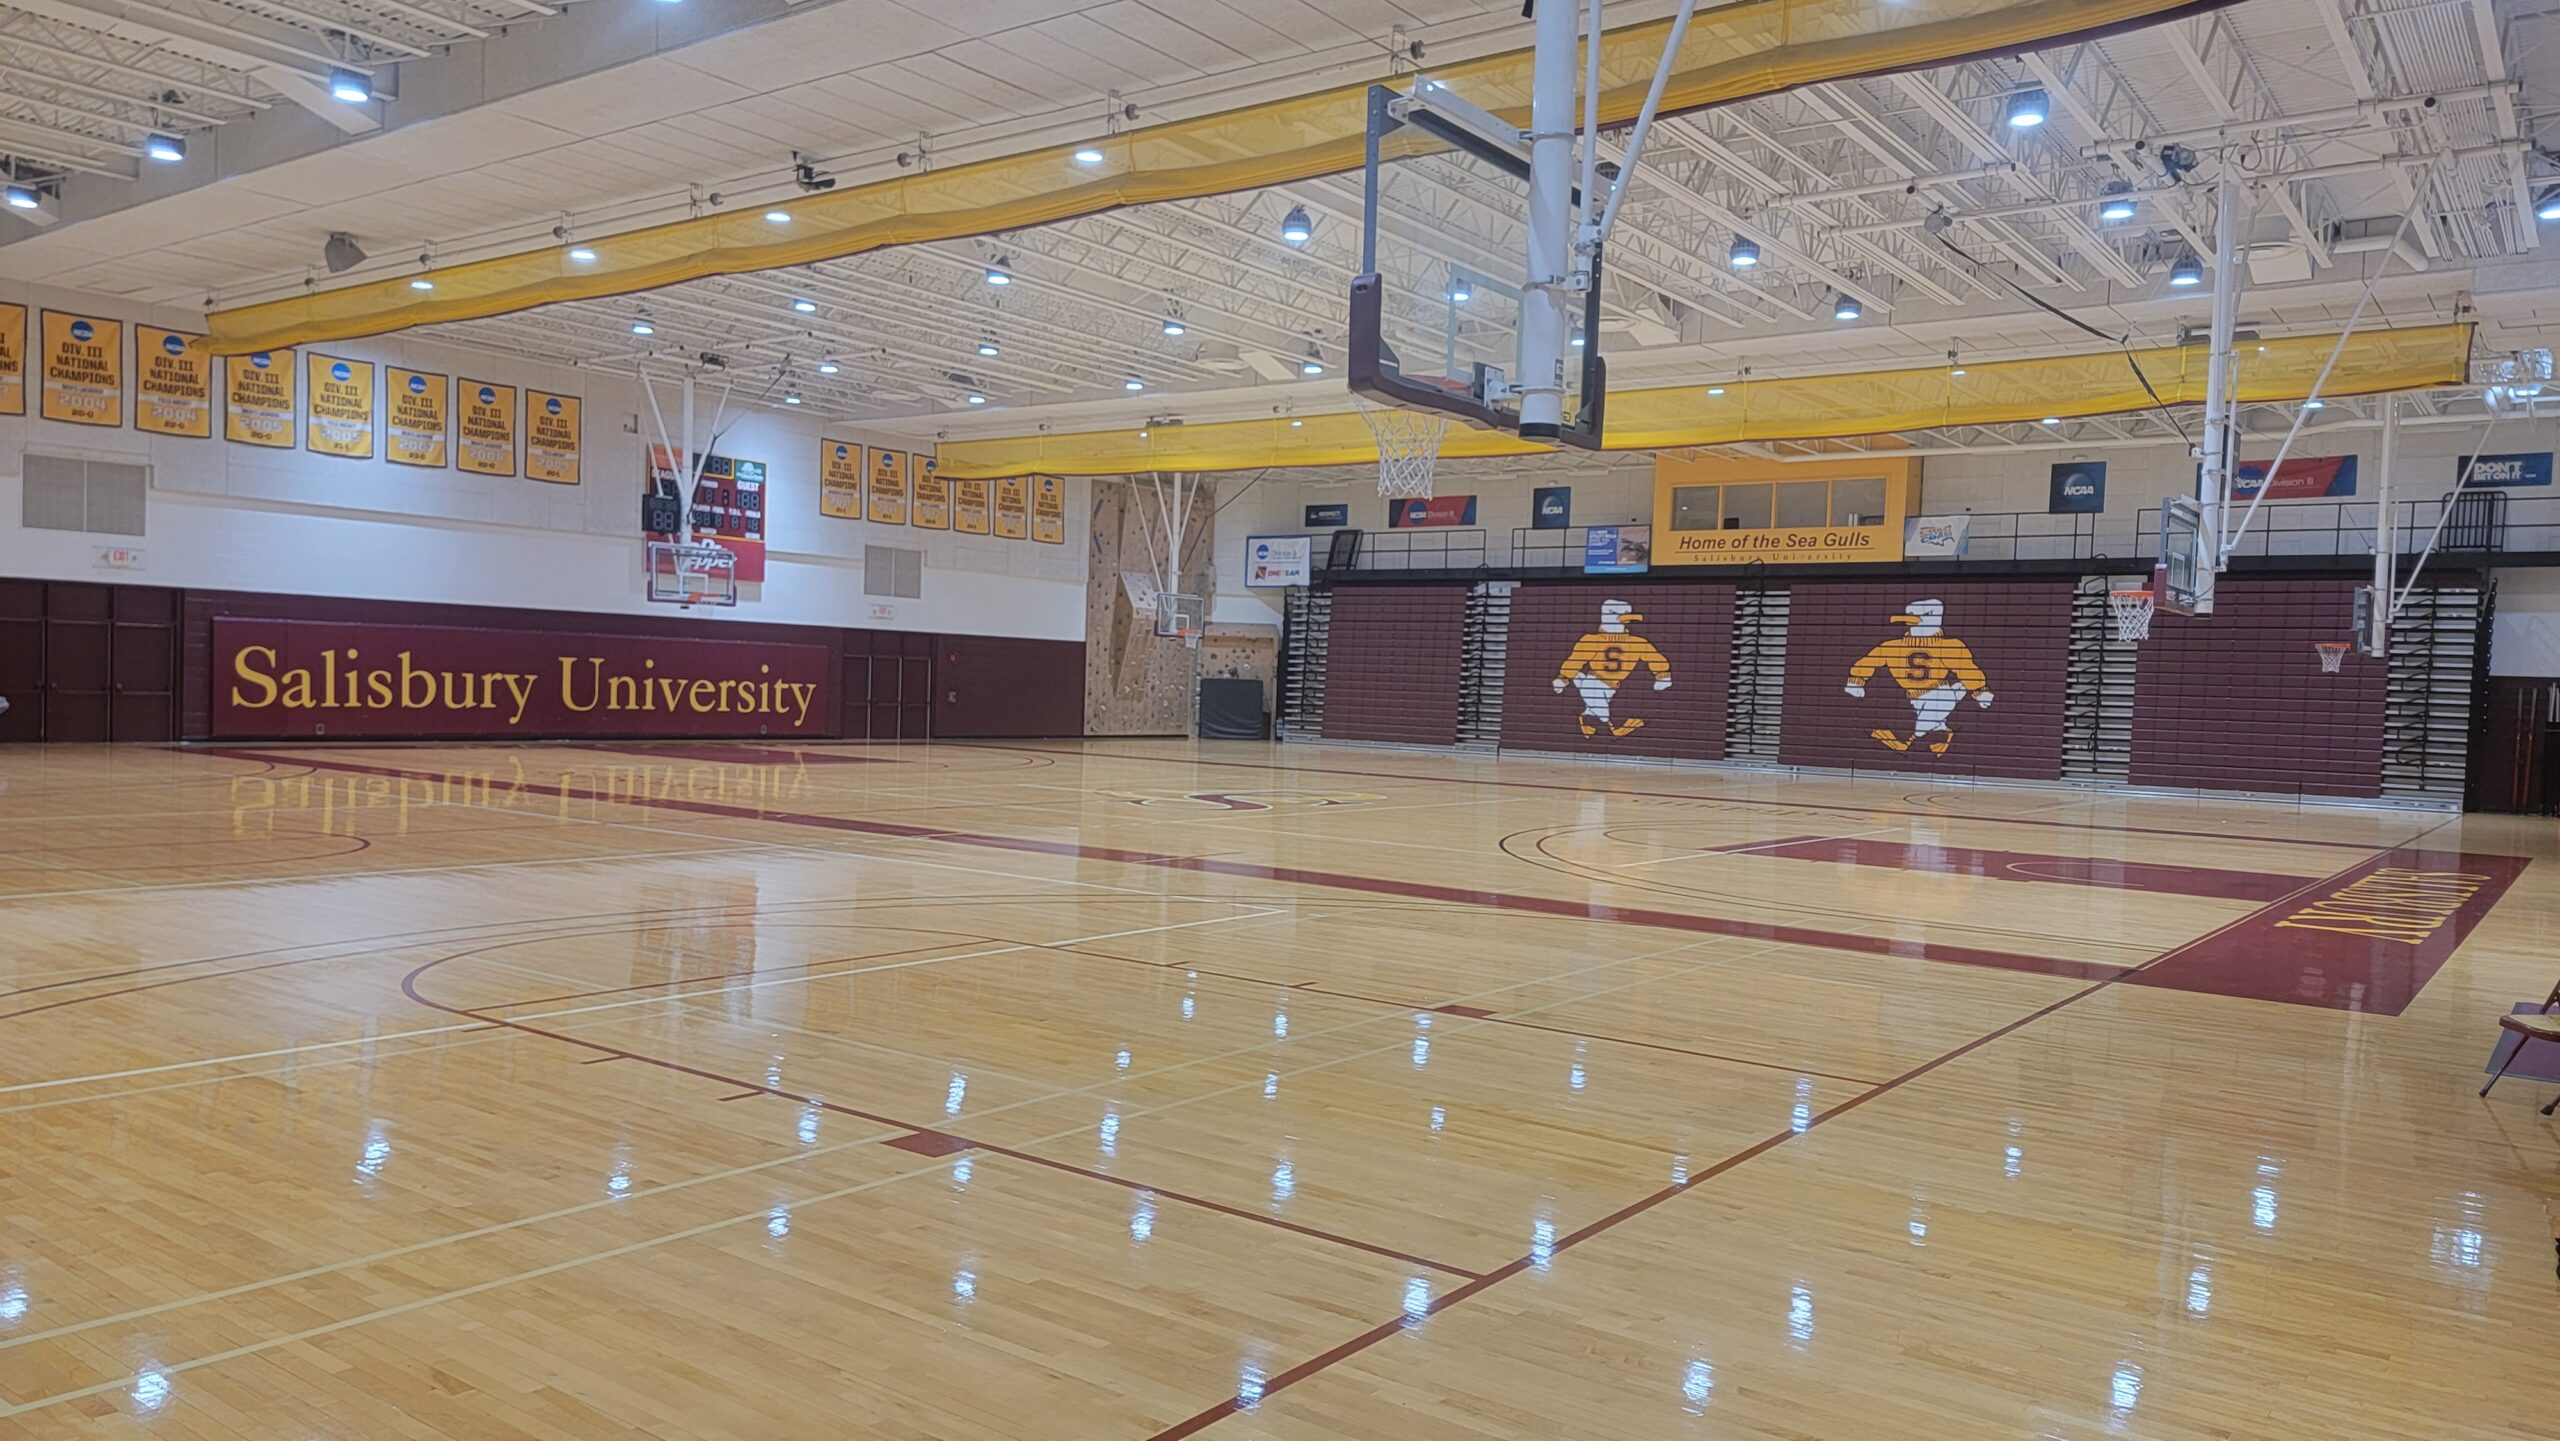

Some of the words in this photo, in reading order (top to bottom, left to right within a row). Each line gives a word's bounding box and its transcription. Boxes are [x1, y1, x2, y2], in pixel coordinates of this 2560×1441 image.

[62, 342, 84, 356] DIV.
[88, 345, 102, 358] III
[56, 354, 109, 371] NATIONAL
[155, 356, 176, 369] DIV.
[179, 360, 193, 371] III
[50, 367, 115, 385] CHAMPIONS
[150, 369, 199, 384] NATIONAL
[243, 370, 262, 382] DIV.
[265, 373, 279, 384] III
[144, 380, 205, 398] CHAMPIONS
[238, 381, 284, 397] NATIONAL
[324, 382, 343, 394] DIV.
[345, 386, 358, 396] III
[232, 392, 290, 409] CHAMPIONS
[320, 394, 363, 408] NATIONAL
[402, 394, 419, 406] DIV.
[421, 397, 432, 408] III
[314, 404, 369, 421] CHAMPIONS
[397, 405, 438, 420] NATIONAL
[472, 405, 488, 416] DIV.
[490, 408, 501, 418] III
[392, 416, 442, 431] CHAMPIONS
[467, 416, 505, 430] NATIONAL
[539, 416, 555, 426] DIV.
[557, 419, 568, 428] III
[463, 426, 510, 441] CHAMPIONS
[536, 426, 571, 439] NATIONAL
[531, 436, 575, 451] CHAMPIONS
[843, 463, 852, 471] III
[2474, 461, 2522, 473] DON'T
[828, 470, 855, 480] NATIONAL
[2474, 472, 2491, 480] BET
[2493, 472, 2510, 480] ON
[2511, 471, 2522, 479] IT
[824, 479, 857, 490] CHAMPIONS
[875, 478, 900, 487] NATIONAL
[918, 484, 942, 493] NATIONAL
[872, 486, 904, 496] CHAMPIONS
[916, 492, 946, 503] CHAMPIONS
[2063, 485, 2094, 496] NCAA
[1541, 506, 1563, 515] NCAA
[1679, 536, 1726, 550] Home
[1730, 535, 1751, 549] of
[1752, 534, 1781, 548] the
[1786, 533, 1817, 548] Sea
[1823, 532, 1870, 547] Gulls
[1604, 646, 1623, 672] S
[1906, 652, 1932, 681] S
[232, 645, 538, 725] Salisbury
[558, 656, 818, 727] University
[2274, 867, 2492, 945] SALISBURY
